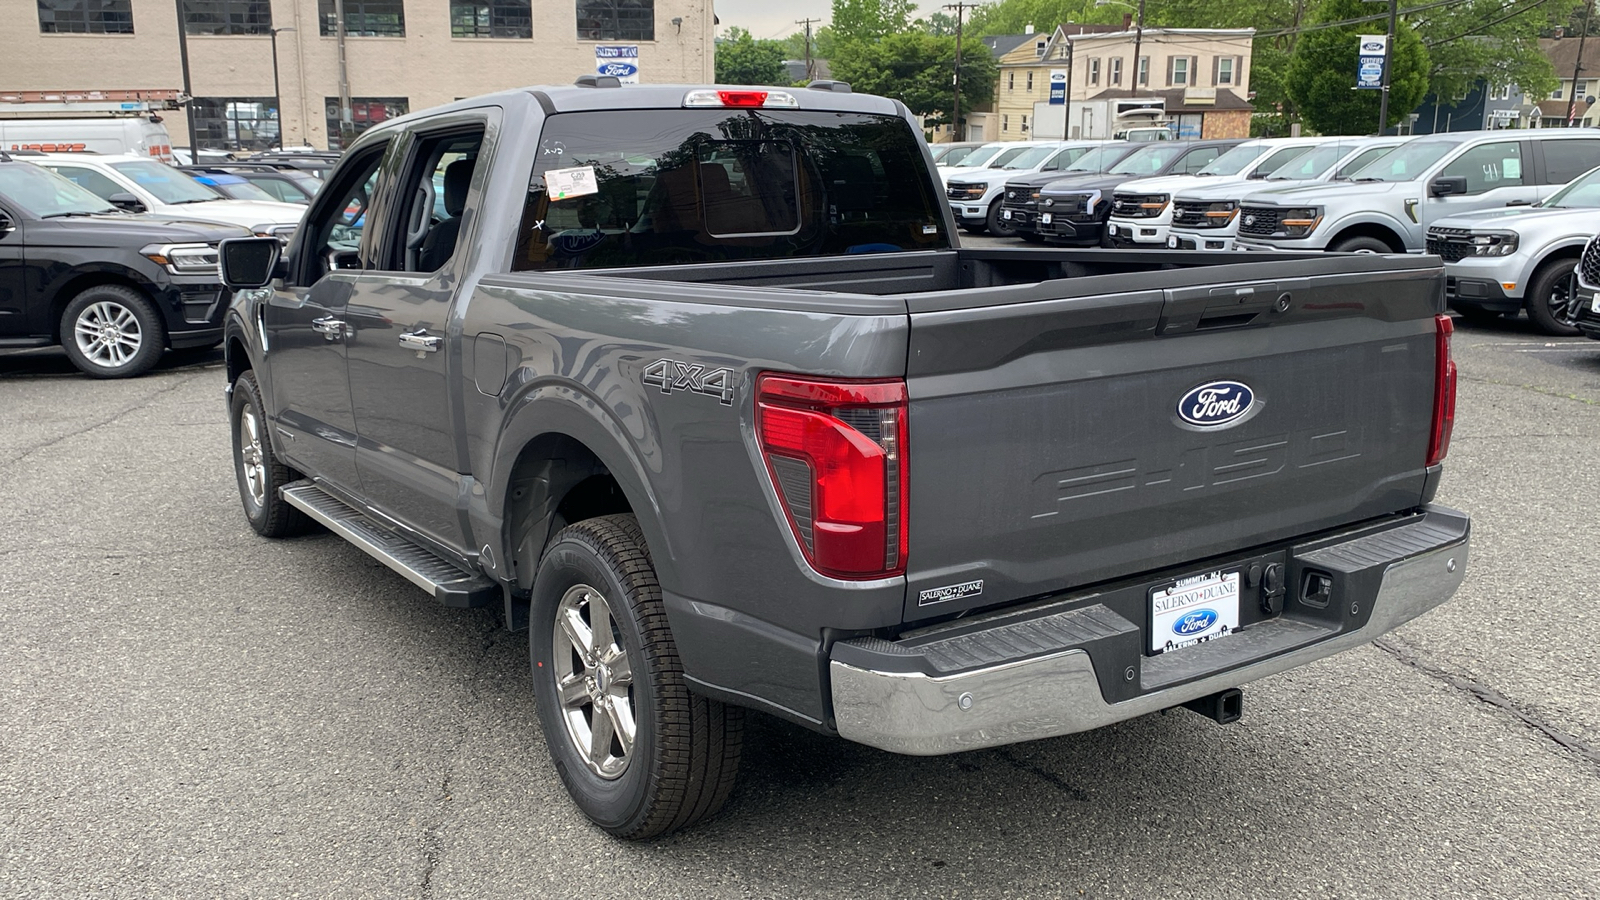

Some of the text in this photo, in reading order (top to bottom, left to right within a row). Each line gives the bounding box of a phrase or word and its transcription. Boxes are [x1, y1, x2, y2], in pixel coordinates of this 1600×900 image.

[605, 64, 631, 76] Ford
[1482, 163, 1498, 180] 41
[1192, 387, 1241, 419] Ford
[1210, 570, 1221, 581] NJ
[921, 582, 981, 600] SALERNO DUANE
[1155, 582, 1236, 612] SALERNO DUANE
[1180, 612, 1210, 633] Ford
[1163, 628, 1233, 653] SALERNO DUANE
